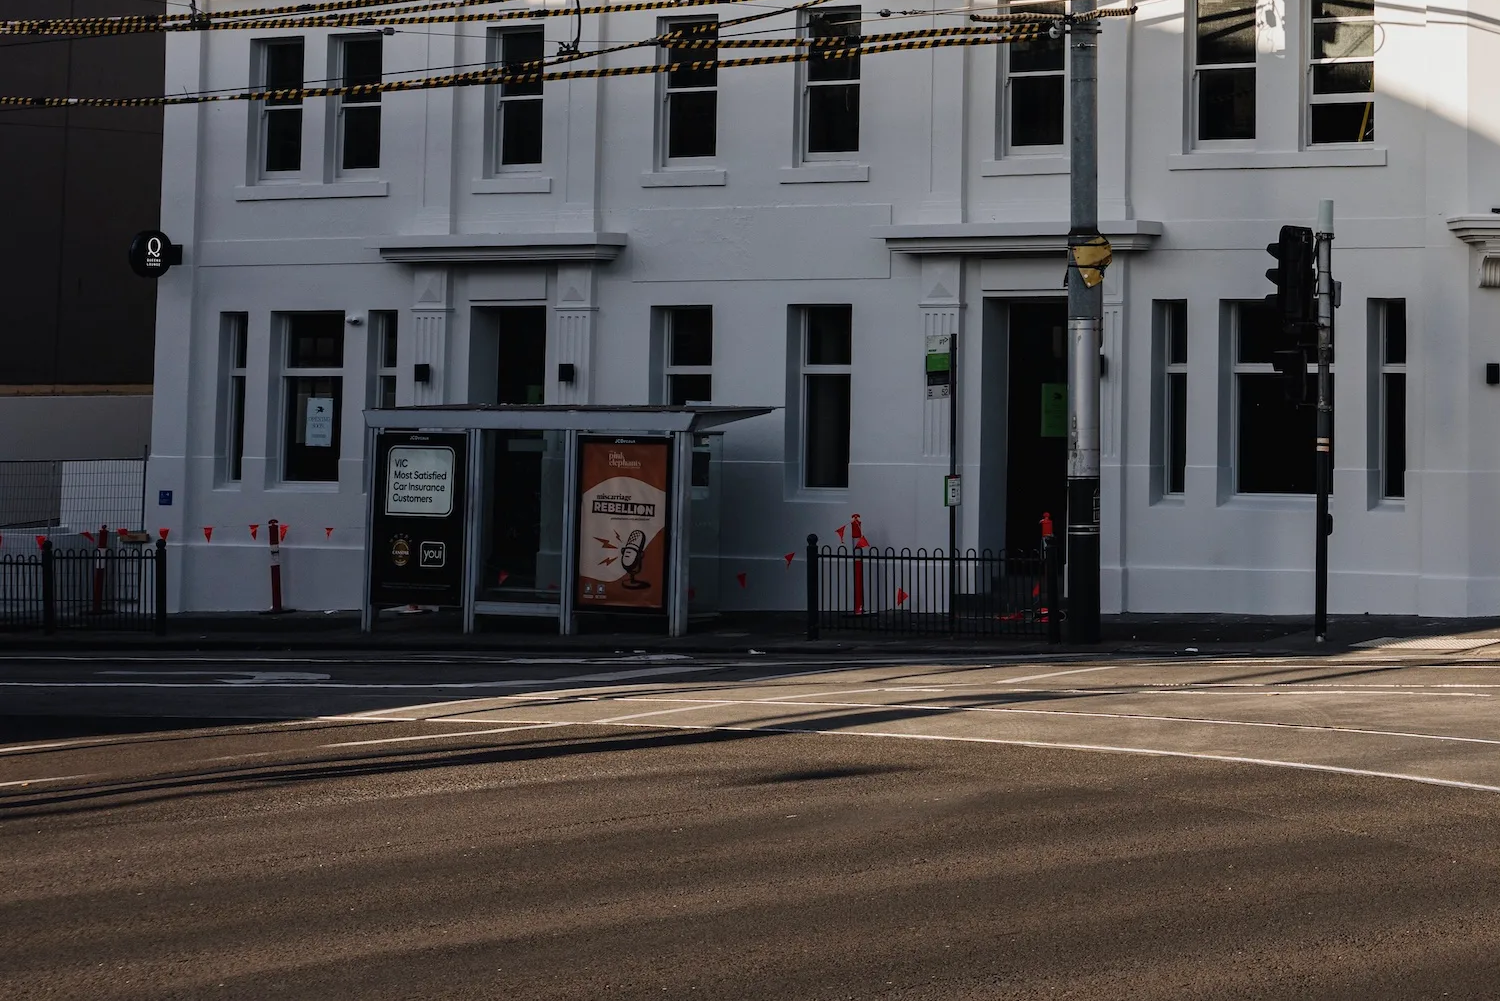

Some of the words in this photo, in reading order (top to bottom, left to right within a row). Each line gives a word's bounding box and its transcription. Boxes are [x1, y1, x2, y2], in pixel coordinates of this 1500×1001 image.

[148, 237, 161, 258] Q
[394, 459, 409, 468] VIC
[394, 471, 412, 480] Most
[413, 471, 447, 480] Satisfied
[393, 482, 407, 491] Car
[408, 482, 446, 492] Insurance
[392, 493, 433, 503] Customers
[596, 493, 632, 501] miscarriage
[593, 501, 654, 516] REBELLION
[423, 546, 443, 563] youi
